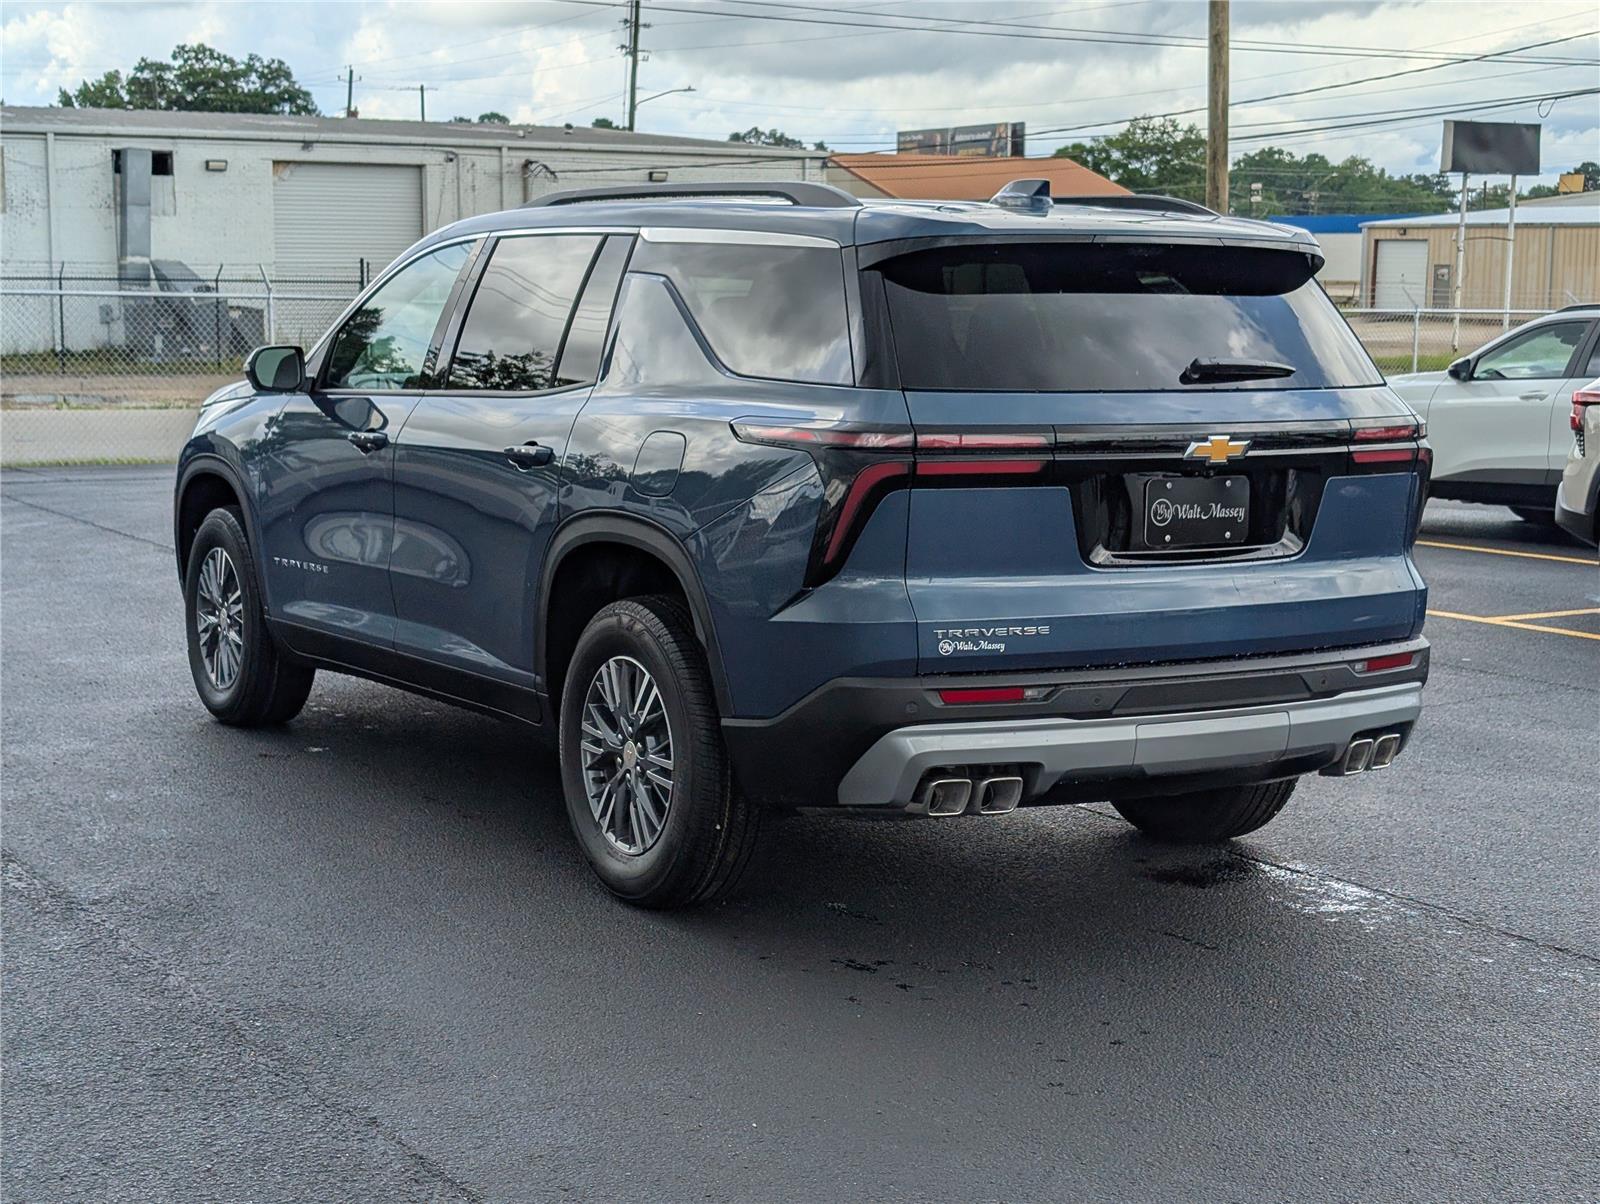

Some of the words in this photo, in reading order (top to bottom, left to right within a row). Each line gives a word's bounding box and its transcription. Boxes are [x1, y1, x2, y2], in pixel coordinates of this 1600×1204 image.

[1172, 503, 1200, 519] Walt
[1201, 502, 1245, 522] Massey
[273, 556, 329, 574] TRAVERSE
[933, 625, 1050, 639] TRAVERSE
[953, 641, 973, 651] Walt
[974, 640, 1005, 652] Massey
